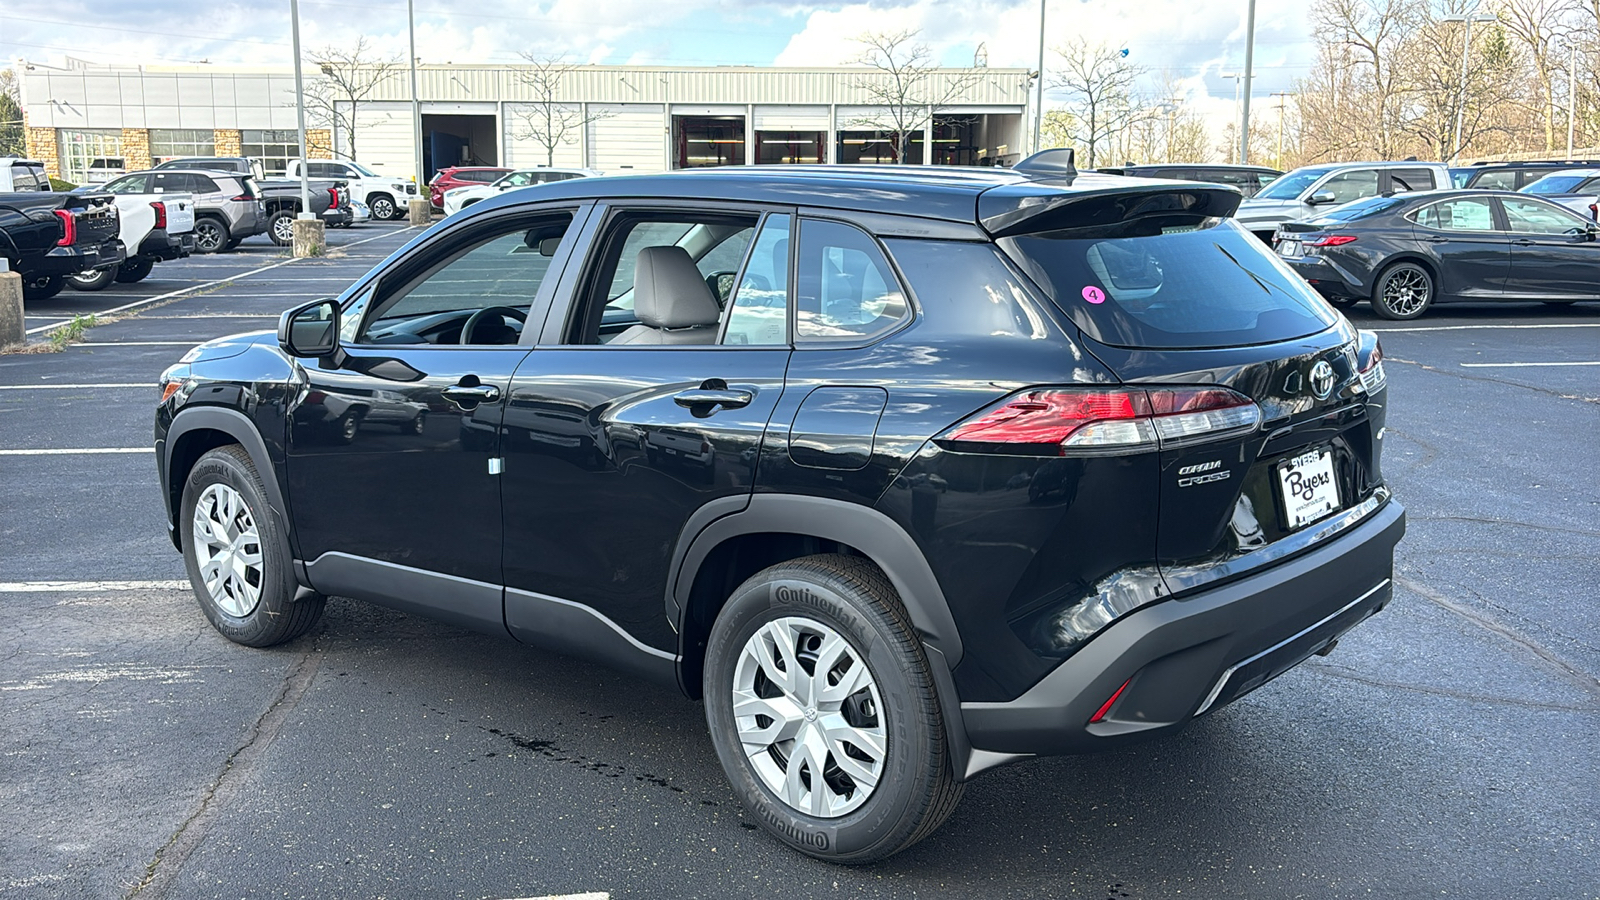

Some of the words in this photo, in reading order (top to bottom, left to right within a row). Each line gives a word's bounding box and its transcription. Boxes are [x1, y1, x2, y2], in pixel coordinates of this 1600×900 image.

[1089, 289, 1098, 301] 4
[191, 464, 225, 486] Continental
[1178, 469, 1231, 488] CROSS
[1179, 459, 1222, 476] COROLLA
[1284, 471, 1330, 501] Byers
[775, 585, 858, 631] Continental
[753, 800, 831, 851] Continental
